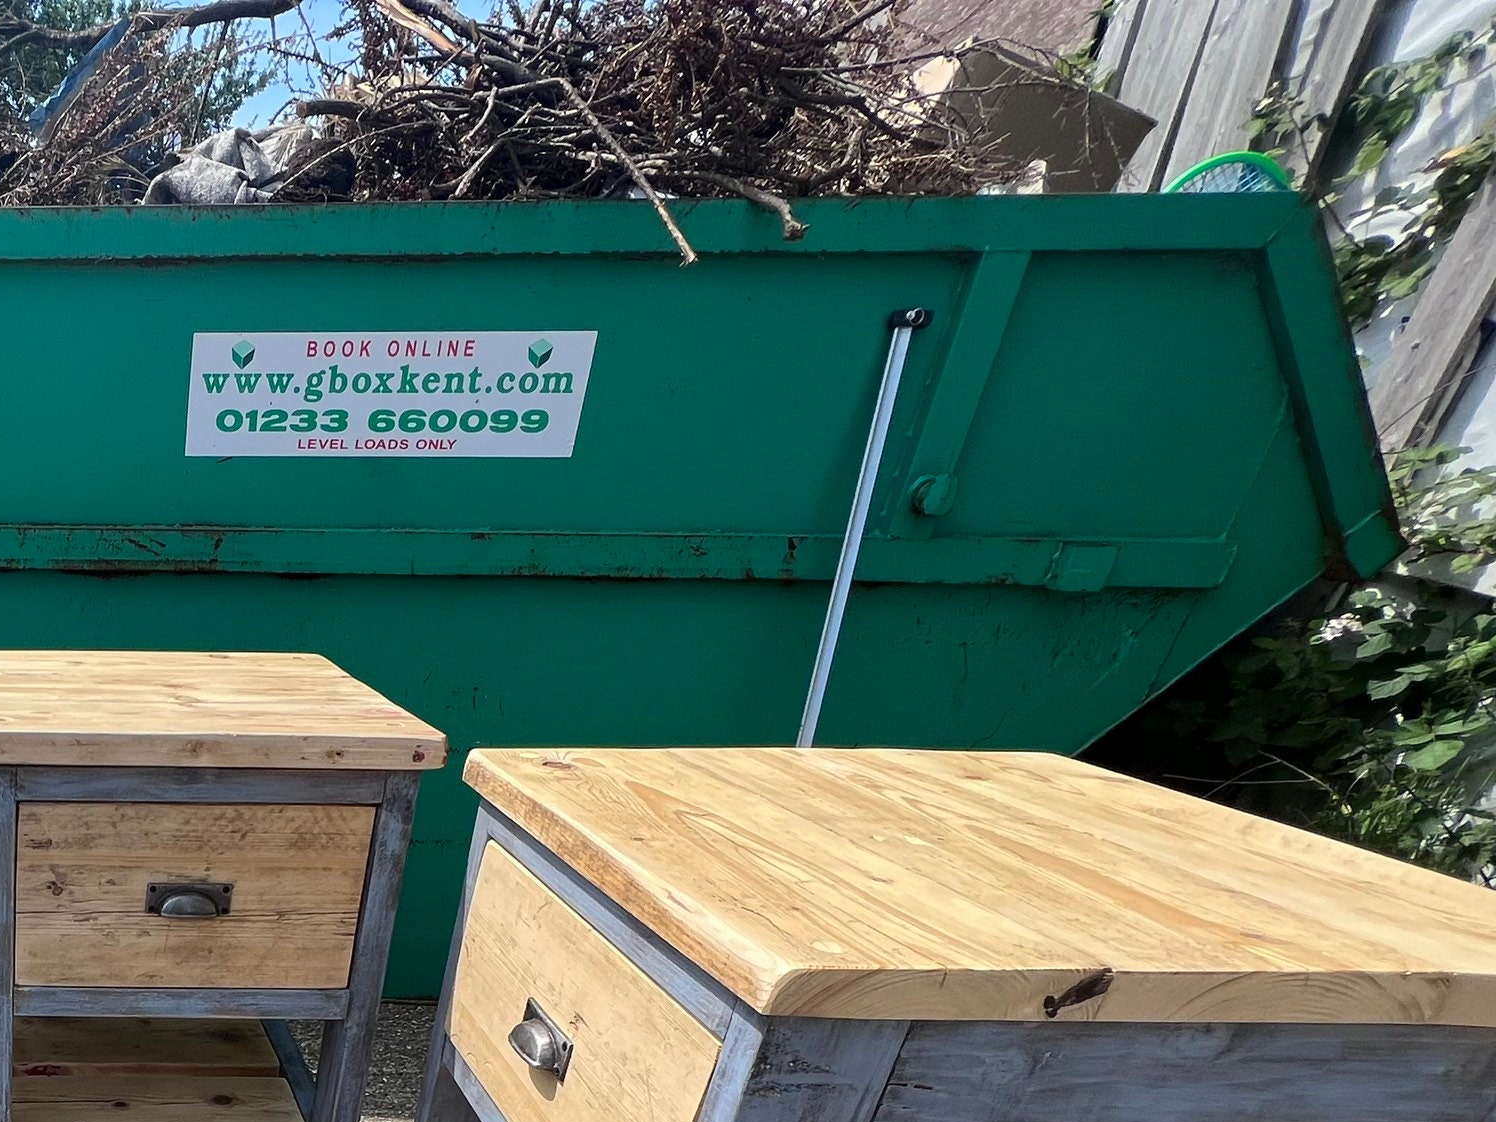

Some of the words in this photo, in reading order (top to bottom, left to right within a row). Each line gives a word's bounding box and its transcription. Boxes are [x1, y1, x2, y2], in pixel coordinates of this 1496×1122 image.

[306, 340, 371, 358] BOOK
[388, 340, 475, 357] ONLINE
[202, 364, 573, 403] www.gboxkent.com
[216, 409, 349, 433] 01233
[367, 409, 549, 433] 660099
[297, 439, 348, 450] LEVEL
[354, 439, 409, 450] LOADS
[415, 439, 457, 450] ONLY
